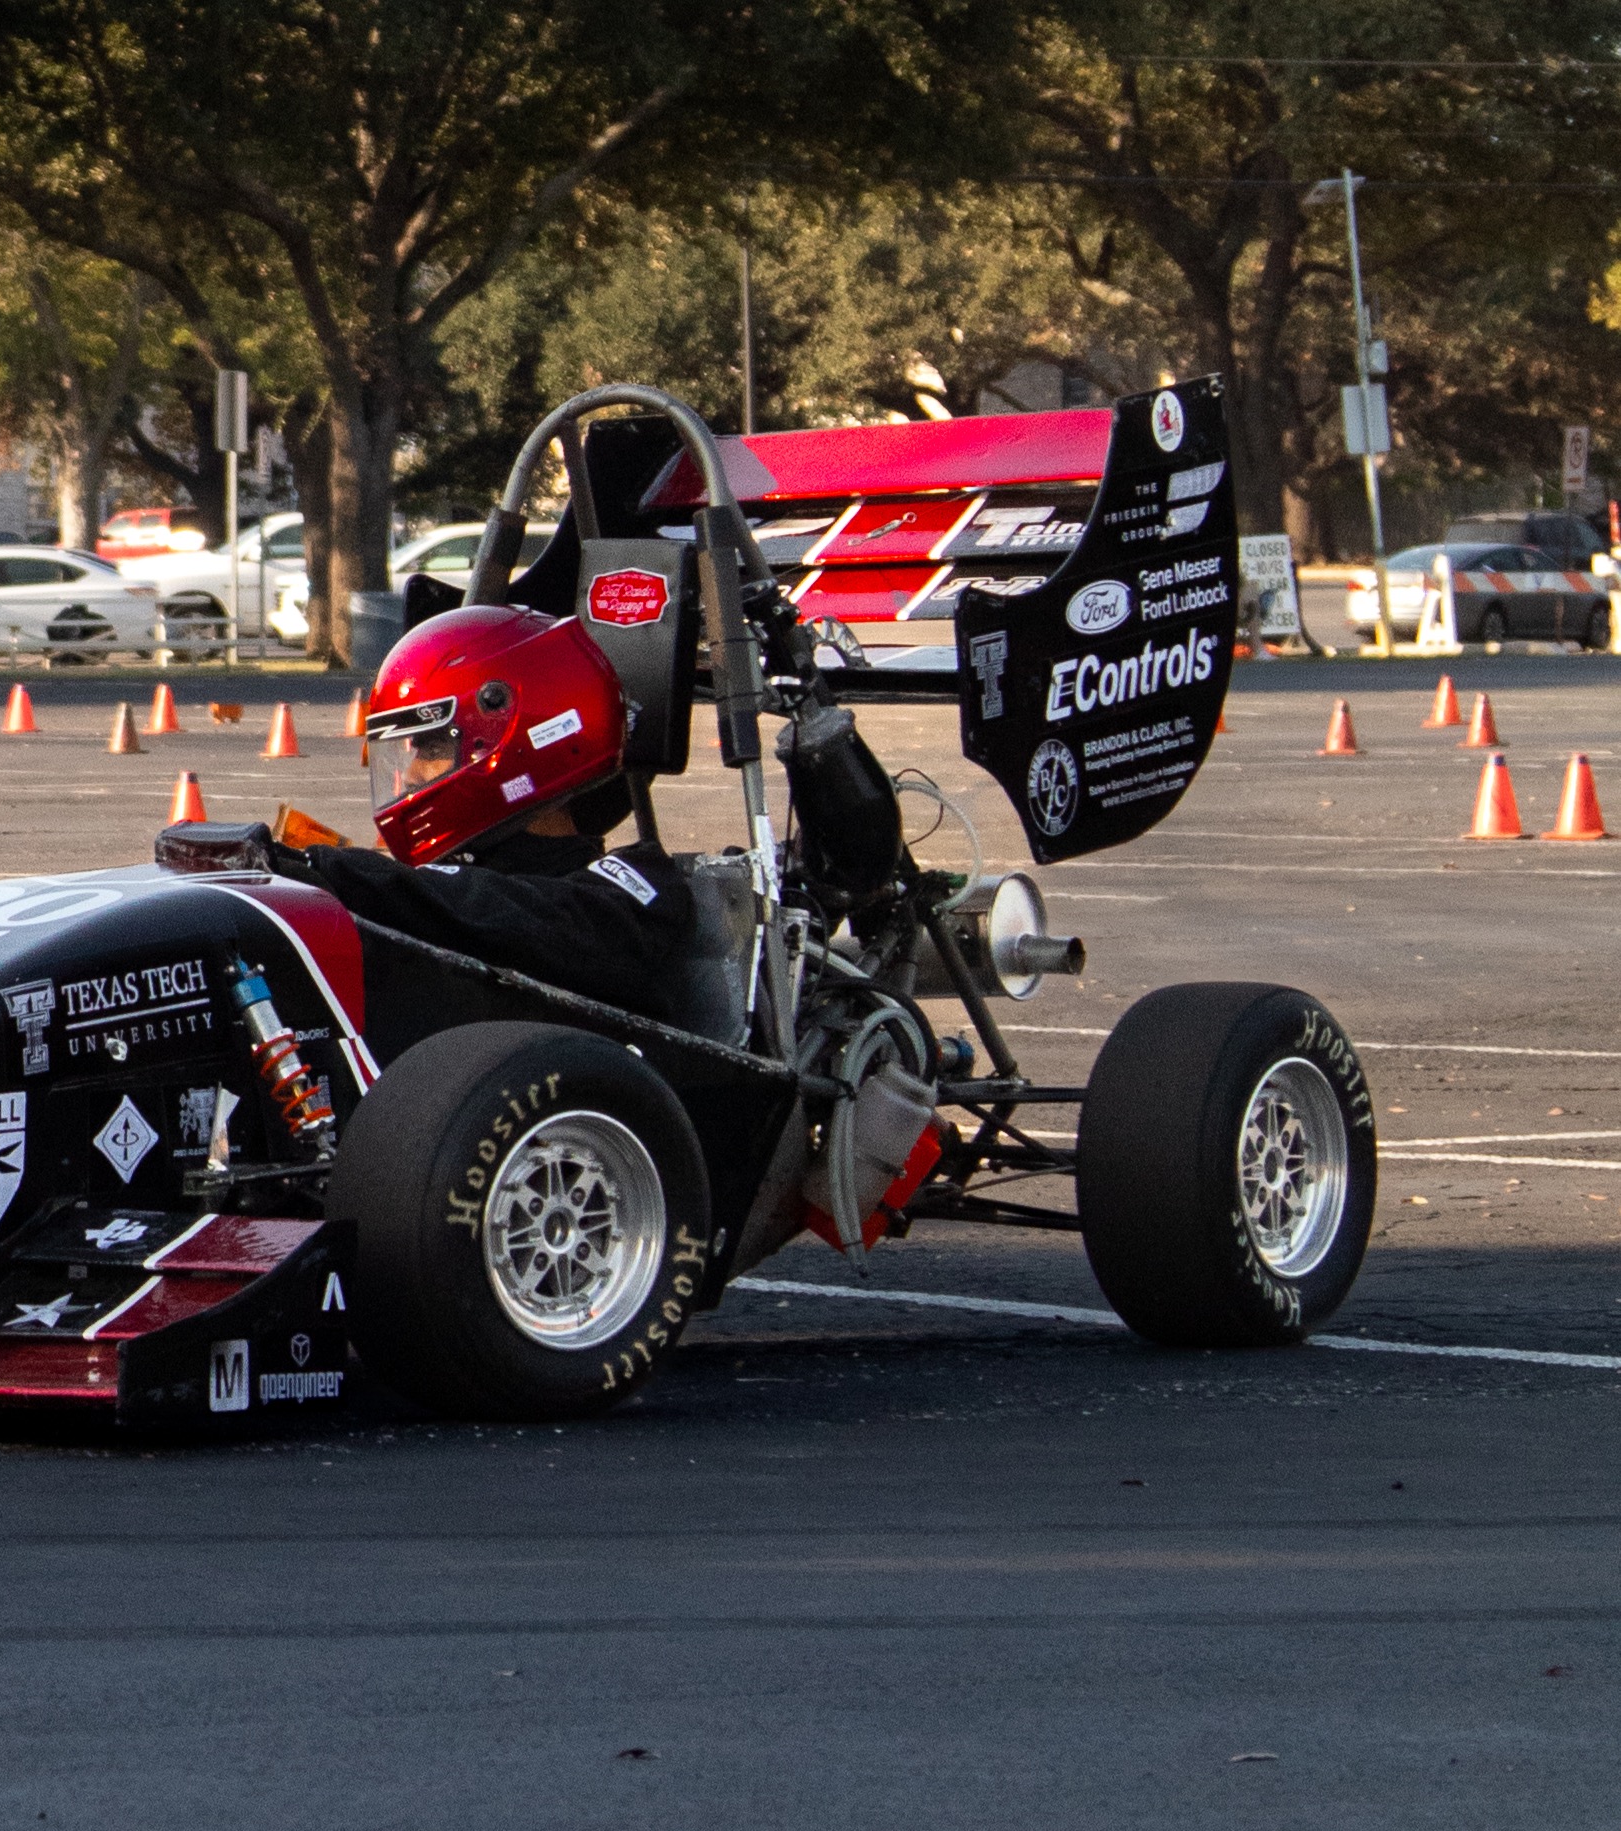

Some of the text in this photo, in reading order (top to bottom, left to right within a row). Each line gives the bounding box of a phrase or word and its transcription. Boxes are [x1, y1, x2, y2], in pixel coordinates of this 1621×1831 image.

[1135, 482, 1158, 496] THE
[1103, 504, 1160, 525] FRIEDKIN
[1009, 536, 1077, 546] METAL
[1121, 525, 1162, 542] GROUP
[1245, 542, 1288, 557] CLOSED
[1139, 556, 1221, 591] Gene Messer
[1081, 590, 1119, 625] Ford
[1141, 581, 1228, 621] Ford Lubbock
[1083, 716, 1193, 757] BRANDON & CLARK, INC.
[61, 960, 208, 1016] TEXAS TECH
[446, 1072, 562, 1240] Hoosier
[259, 1371, 344, 1406] goengineer
